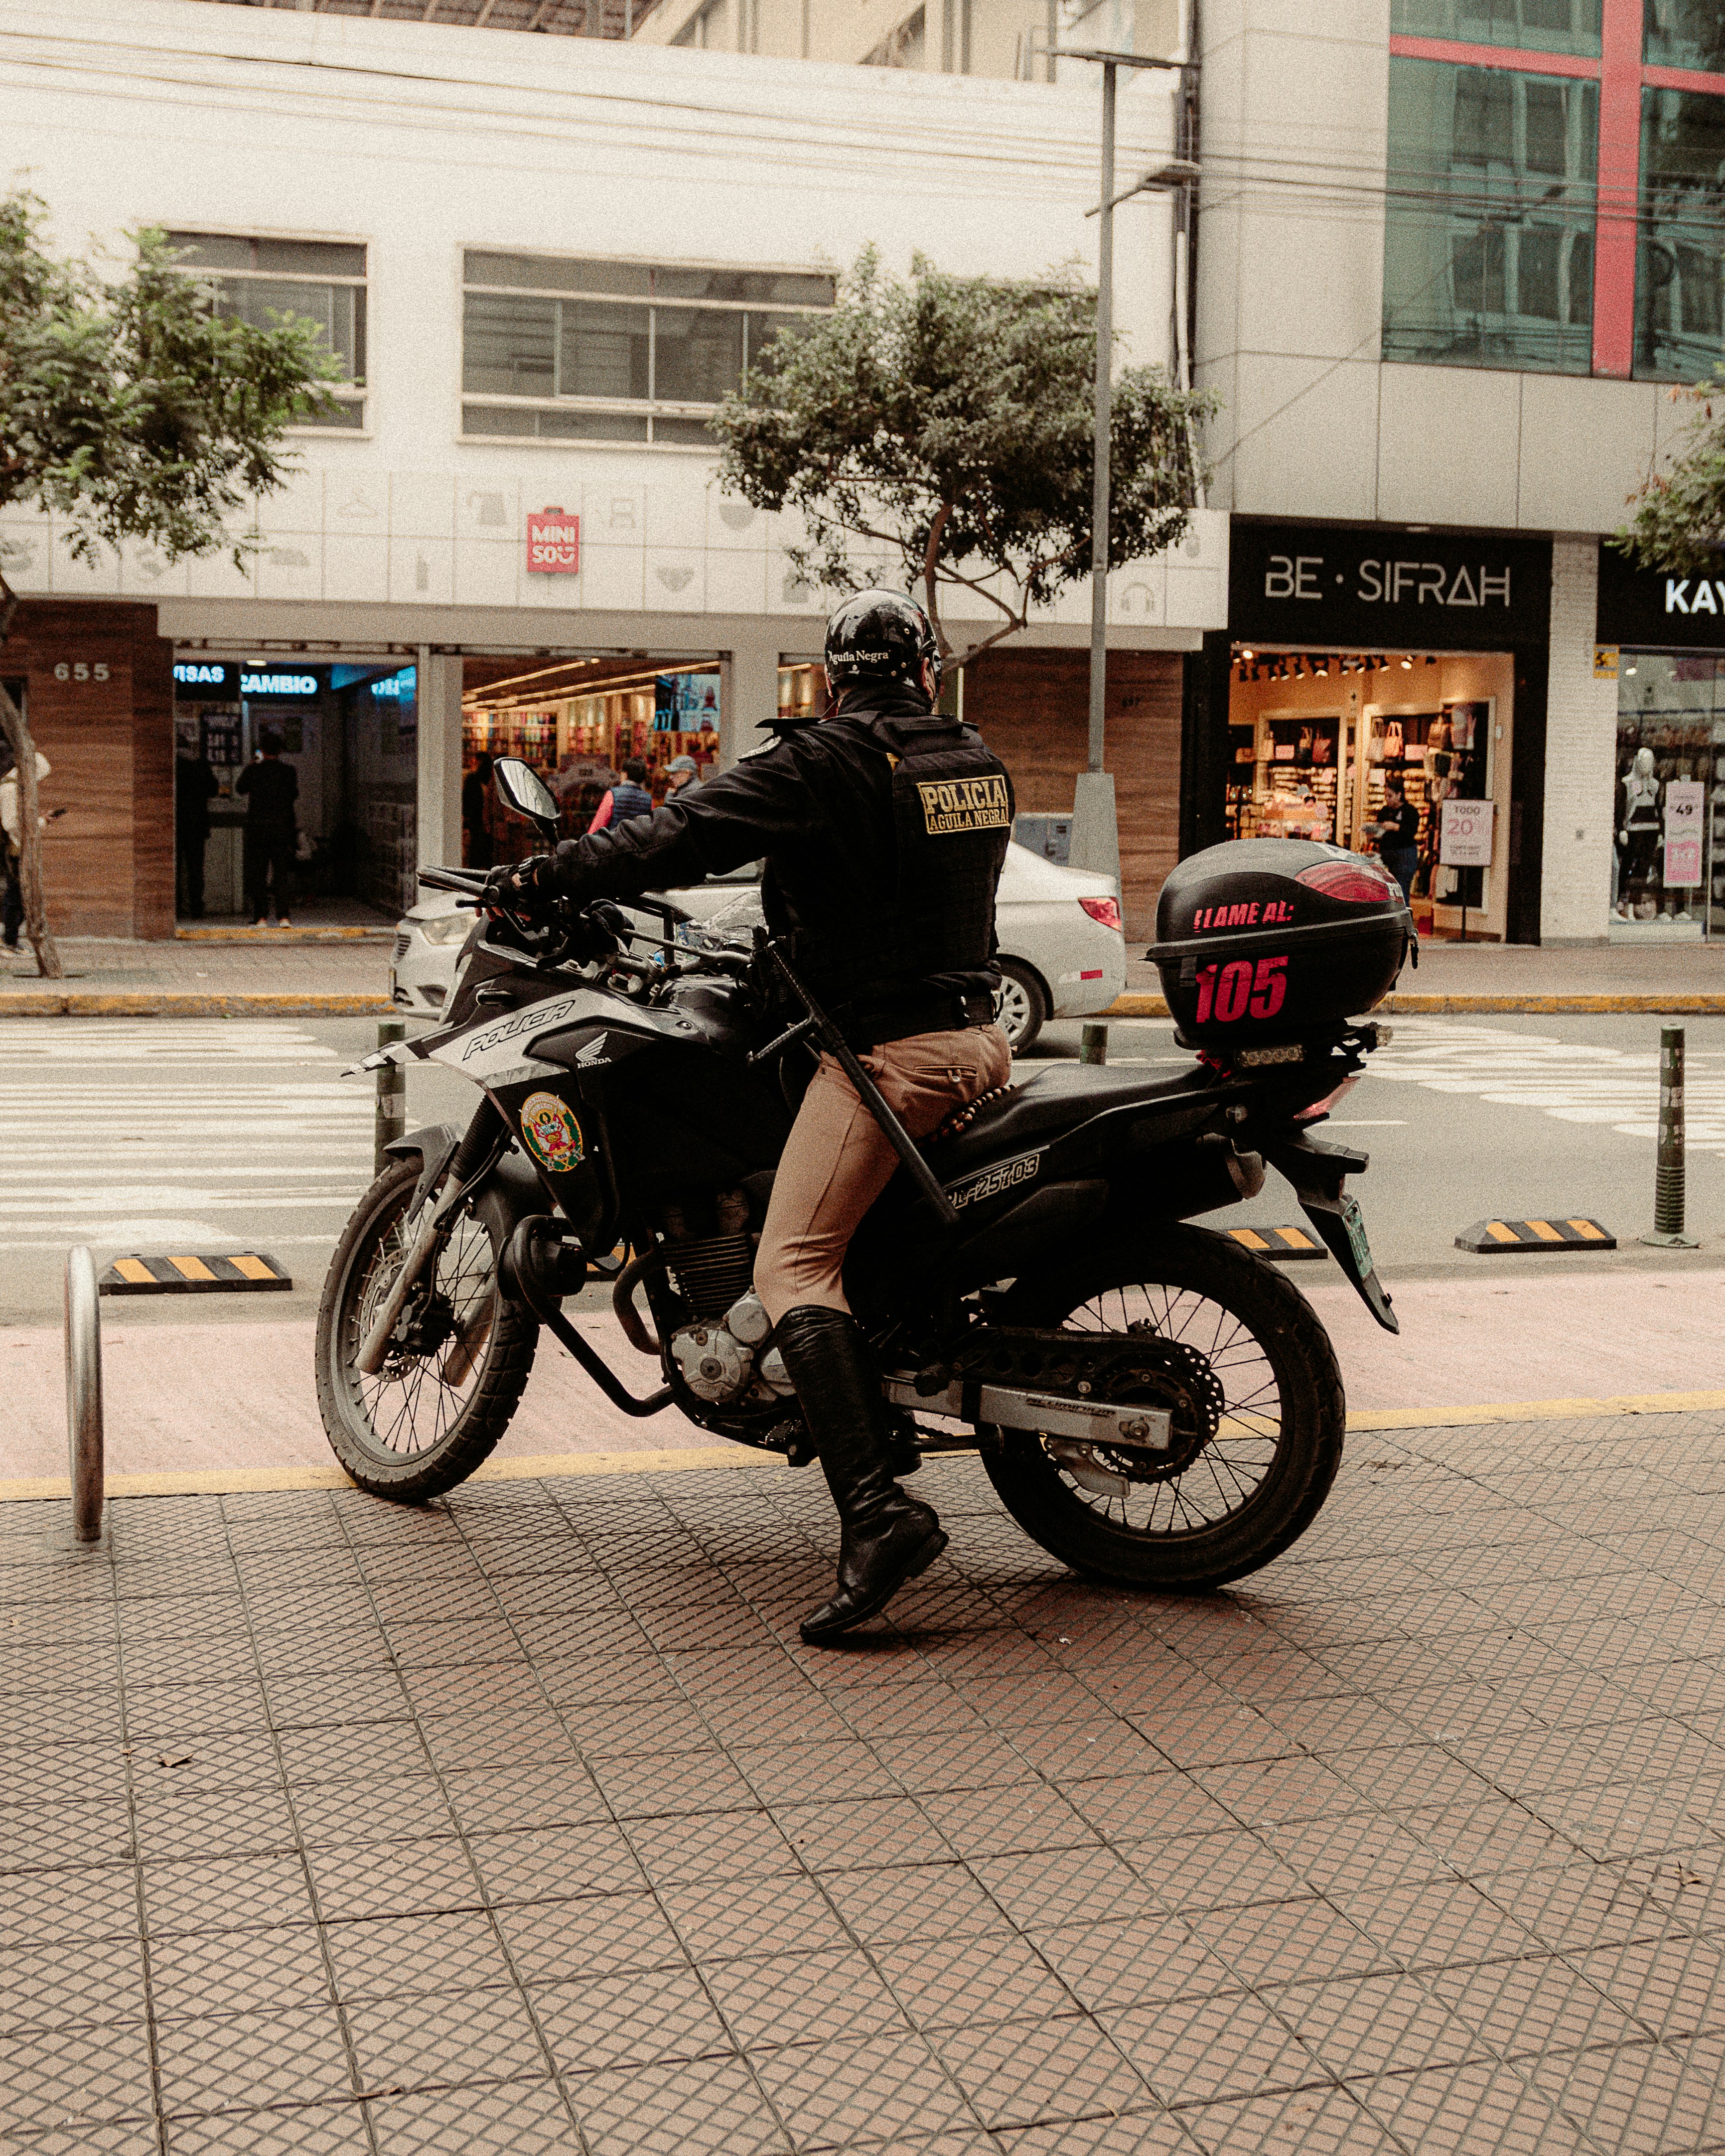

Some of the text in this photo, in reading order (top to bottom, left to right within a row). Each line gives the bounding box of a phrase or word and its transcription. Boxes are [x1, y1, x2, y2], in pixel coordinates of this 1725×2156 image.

[532, 526, 575, 543] MINI
[1266, 555, 1510, 607] BE SIFRAH
[54, 662, 110, 682] 655
[921, 780, 1006, 814] POLICIA
[1676, 804, 1693, 815] 49
[929, 808, 1006, 831] AGUILA NEGRA
[1196, 956, 1289, 1023] 105
[462, 1000, 575, 1061] POLICIA
[577, 1057, 612, 1068] HONDA
[947, 1153, 1040, 1209] L-25703
